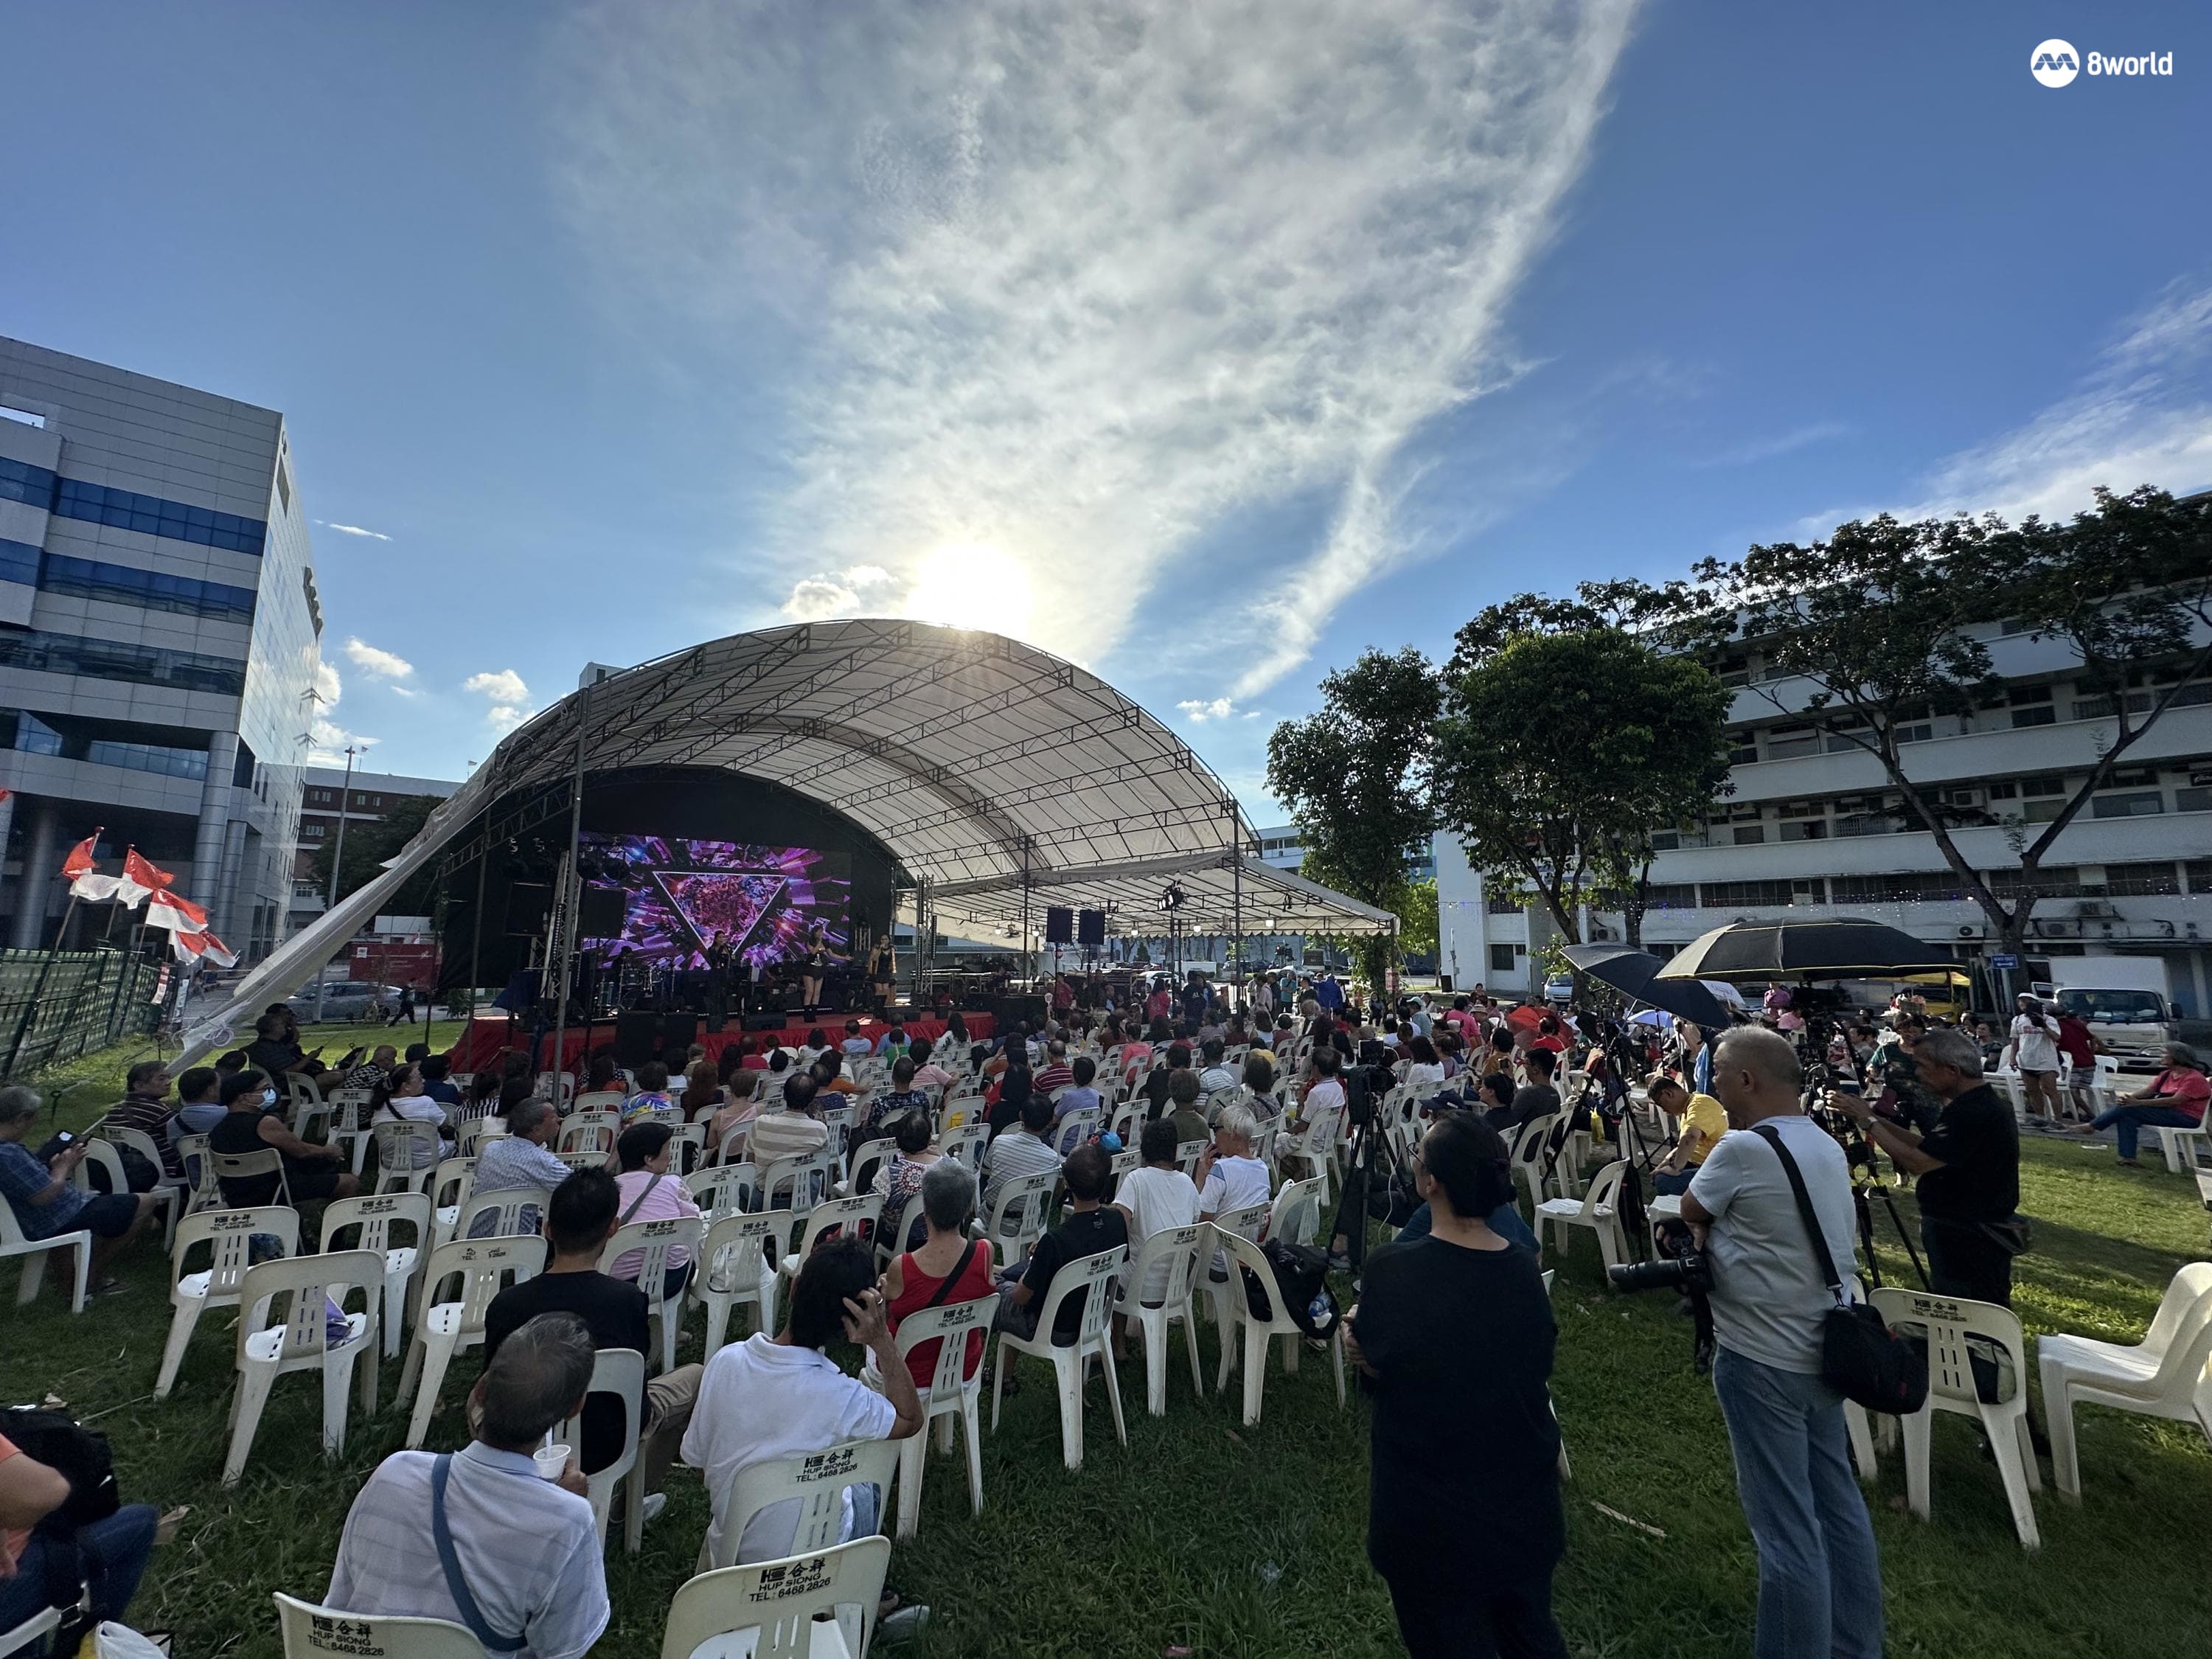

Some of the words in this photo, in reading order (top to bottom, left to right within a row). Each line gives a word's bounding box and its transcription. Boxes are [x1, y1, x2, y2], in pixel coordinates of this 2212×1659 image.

[818, 1469, 838, 1478] 6468
[839, 1463, 858, 1474] 2826
[824, 1460, 850, 1470] SIONG
[759, 1582, 782, 1591] HUP
[785, 1573, 821, 1587] SIONG
[778, 1585, 804, 1598] 6468
[807, 1577, 831, 1591] 2826
[313, 1630, 333, 1639] HUP
[336, 1635, 371, 1646] SIONG
[358, 1646, 384, 1655] 2826
